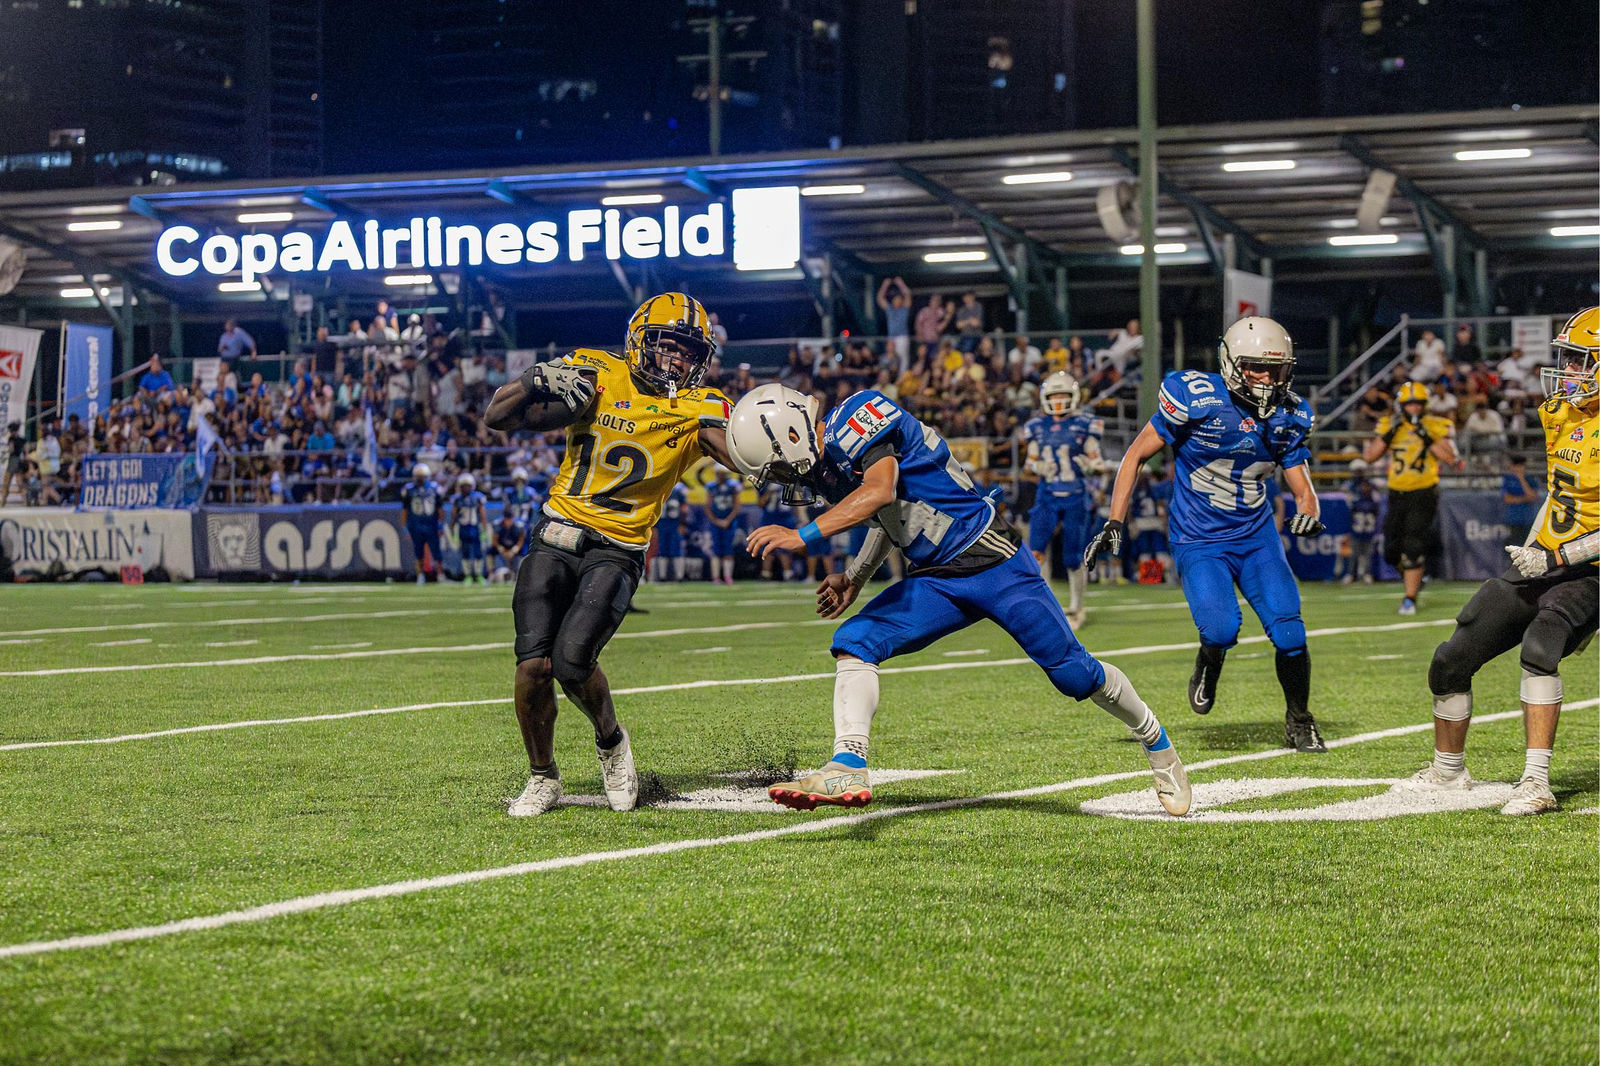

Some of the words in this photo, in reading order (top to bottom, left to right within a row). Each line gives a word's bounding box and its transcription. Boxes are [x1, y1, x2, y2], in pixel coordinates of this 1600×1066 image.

[569, 202, 725, 261] Field
[649, 421, 686, 436] prival
[867, 420, 889, 439] KFC
[85, 459, 118, 481] LET'S
[567, 433, 648, 513] 12
[1391, 448, 1426, 474] 54
[84, 482, 159, 506] DRAGONS
[1551, 468, 1577, 535] 5
[0, 518, 134, 562] CRISTALIN
[264, 519, 400, 570] assa
